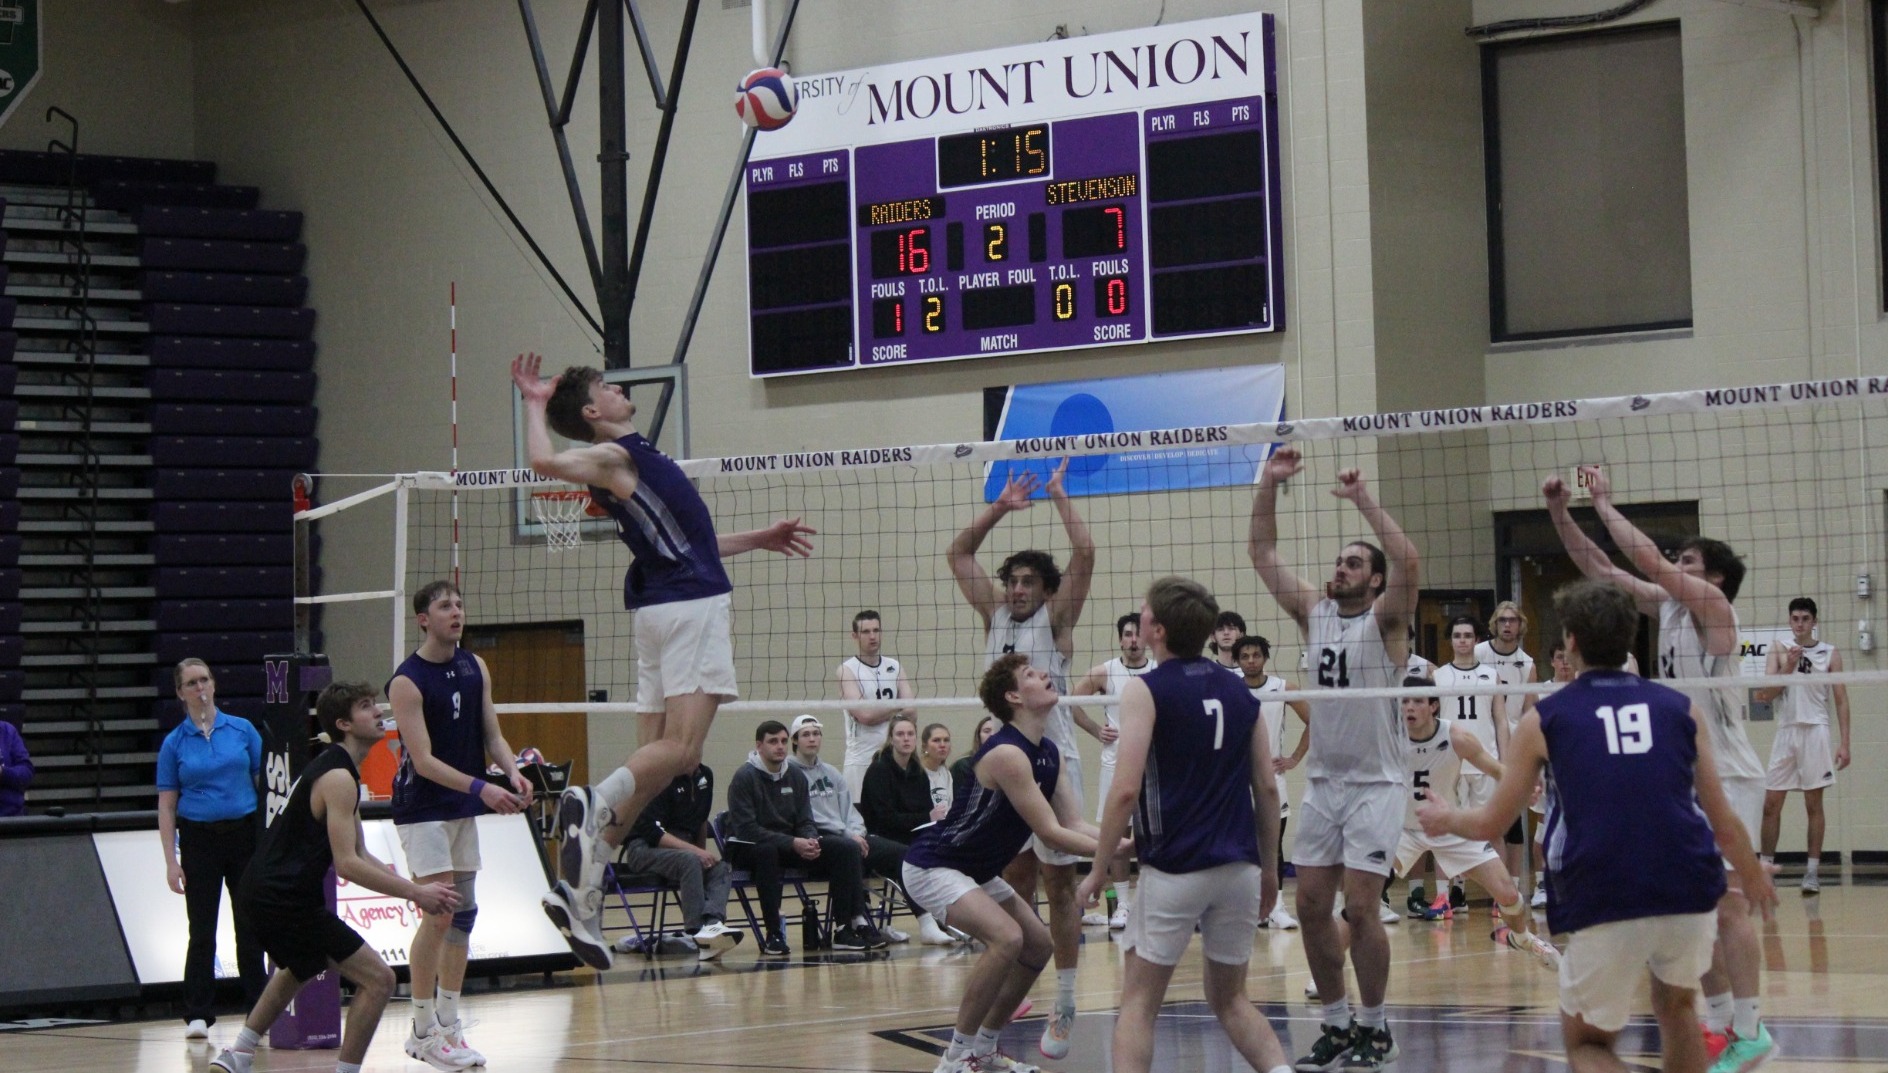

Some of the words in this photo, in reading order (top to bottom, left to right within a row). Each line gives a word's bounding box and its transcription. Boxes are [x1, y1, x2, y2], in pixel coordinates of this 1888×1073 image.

[867, 60, 1045, 125] MOUNT
[1063, 31, 1250, 98] UNION
[1151, 115, 1175, 131] PLYR
[1193, 110, 1209, 125] FLS
[1232, 106, 1250, 121] PTS
[981, 130, 1045, 177] 1:15
[752, 167, 773, 182] PLYR
[789, 163, 803, 178] FLS
[823, 158, 839, 173] PTS
[1047, 175, 1136, 204] STEVENSON
[871, 199, 931, 225] RAIDERS
[976, 202, 1016, 220] PERIOD
[988, 225, 1004, 260] 2
[1104, 207, 1124, 249] 7
[899, 229, 929, 273] 16
[959, 272, 1000, 290] PLAYER
[1008, 268, 1036, 285] FOUL
[1049, 264, 1080, 281] T.O.L.
[1092, 258, 1129, 276] FOULS
[871, 281, 905, 298] FOULS
[919, 277, 949, 293] T.O.L.
[1107, 279, 1125, 314] 0
[926, 297, 941, 331] 2
[1056, 284, 1073, 319] 0
[895, 303, 902, 332] 1
[1094, 323, 1131, 341] SCORE
[872, 344, 907, 361] SCORE
[980, 334, 1018, 351] MATCH
[1705, 385, 1781, 407] MOUNT
[1790, 379, 1859, 399] UNION
[1343, 413, 1412, 432] MOUNT
[1420, 407, 1483, 426] UNION
[1491, 401, 1578, 422] RAIDERS
[1015, 436, 1078, 454] MOUNT
[1085, 431, 1142, 449] UNION
[1150, 426, 1228, 446] RAIDERS
[721, 455, 777, 473] MOUNT
[783, 452, 834, 468] UNION
[841, 447, 912, 465] RAIDERS
[456, 471, 507, 486] MOUNT
[265, 660, 289, 704] M
[1318, 647, 1350, 688] 21
[452, 691, 461, 720] 9
[1202, 698, 1224, 750] 7
[1595, 703, 1653, 755] 19
[1413, 770, 1430, 801] 5
[341, 901, 408, 930] Agency
